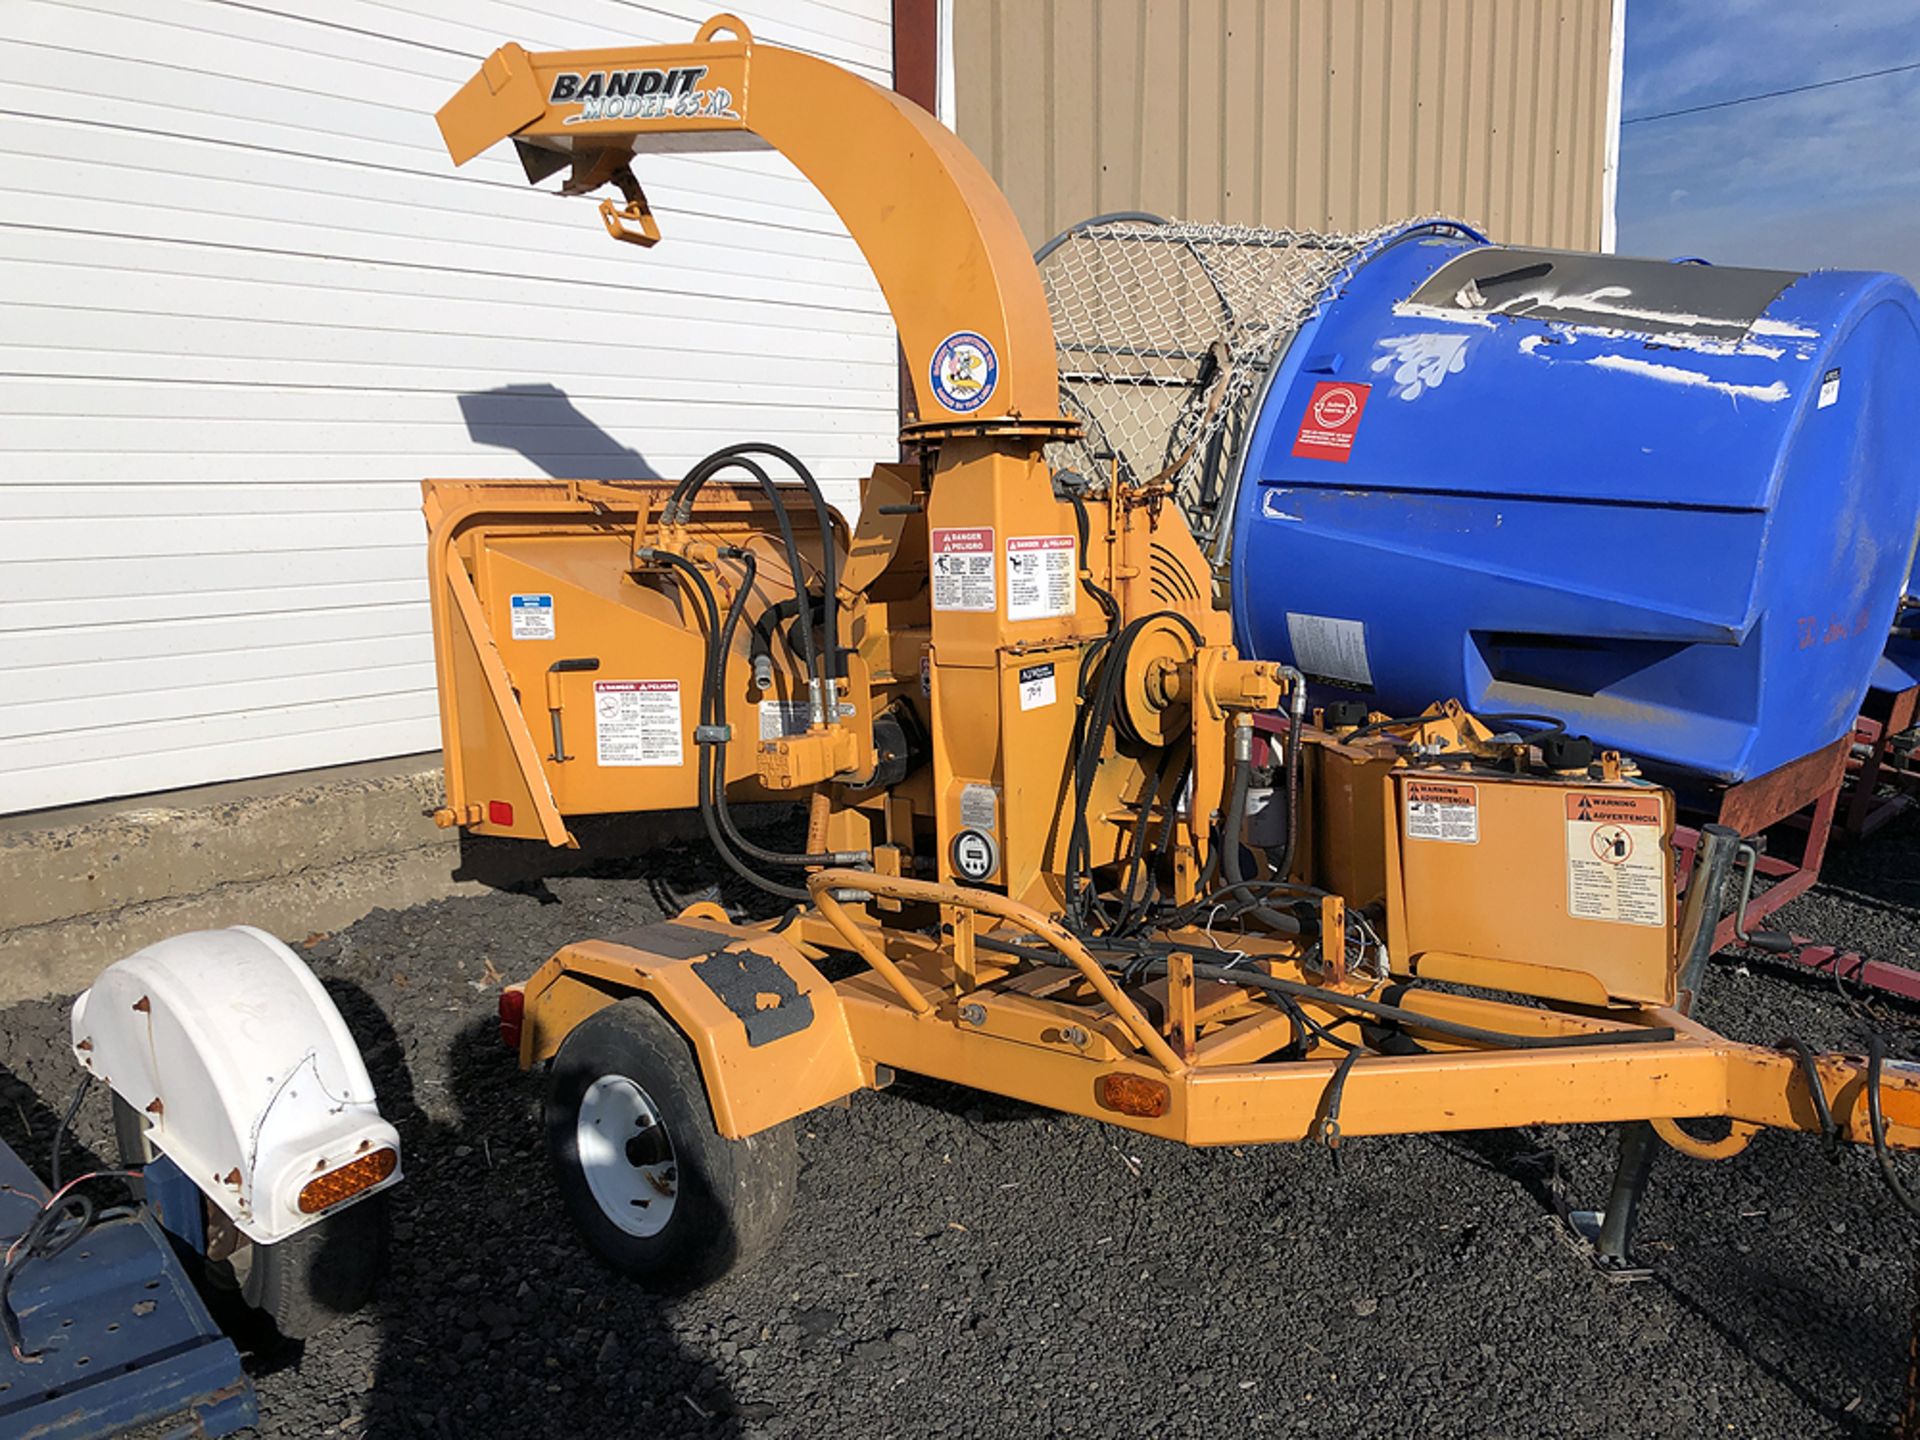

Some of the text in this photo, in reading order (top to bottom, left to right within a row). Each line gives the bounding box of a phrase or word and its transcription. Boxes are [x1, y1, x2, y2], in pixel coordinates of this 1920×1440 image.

[551, 67, 707, 102] BANDIT
[582, 94, 668, 120] MODEL
[674, 91, 704, 117] 65
[952, 533, 982, 541] DANGER
[952, 542, 984, 550] PELIGRO
[1420, 786, 1459, 794] WARNING
[1593, 799, 1637, 808] WARNING
[1593, 813, 1658, 823] ADVERTENCIA
